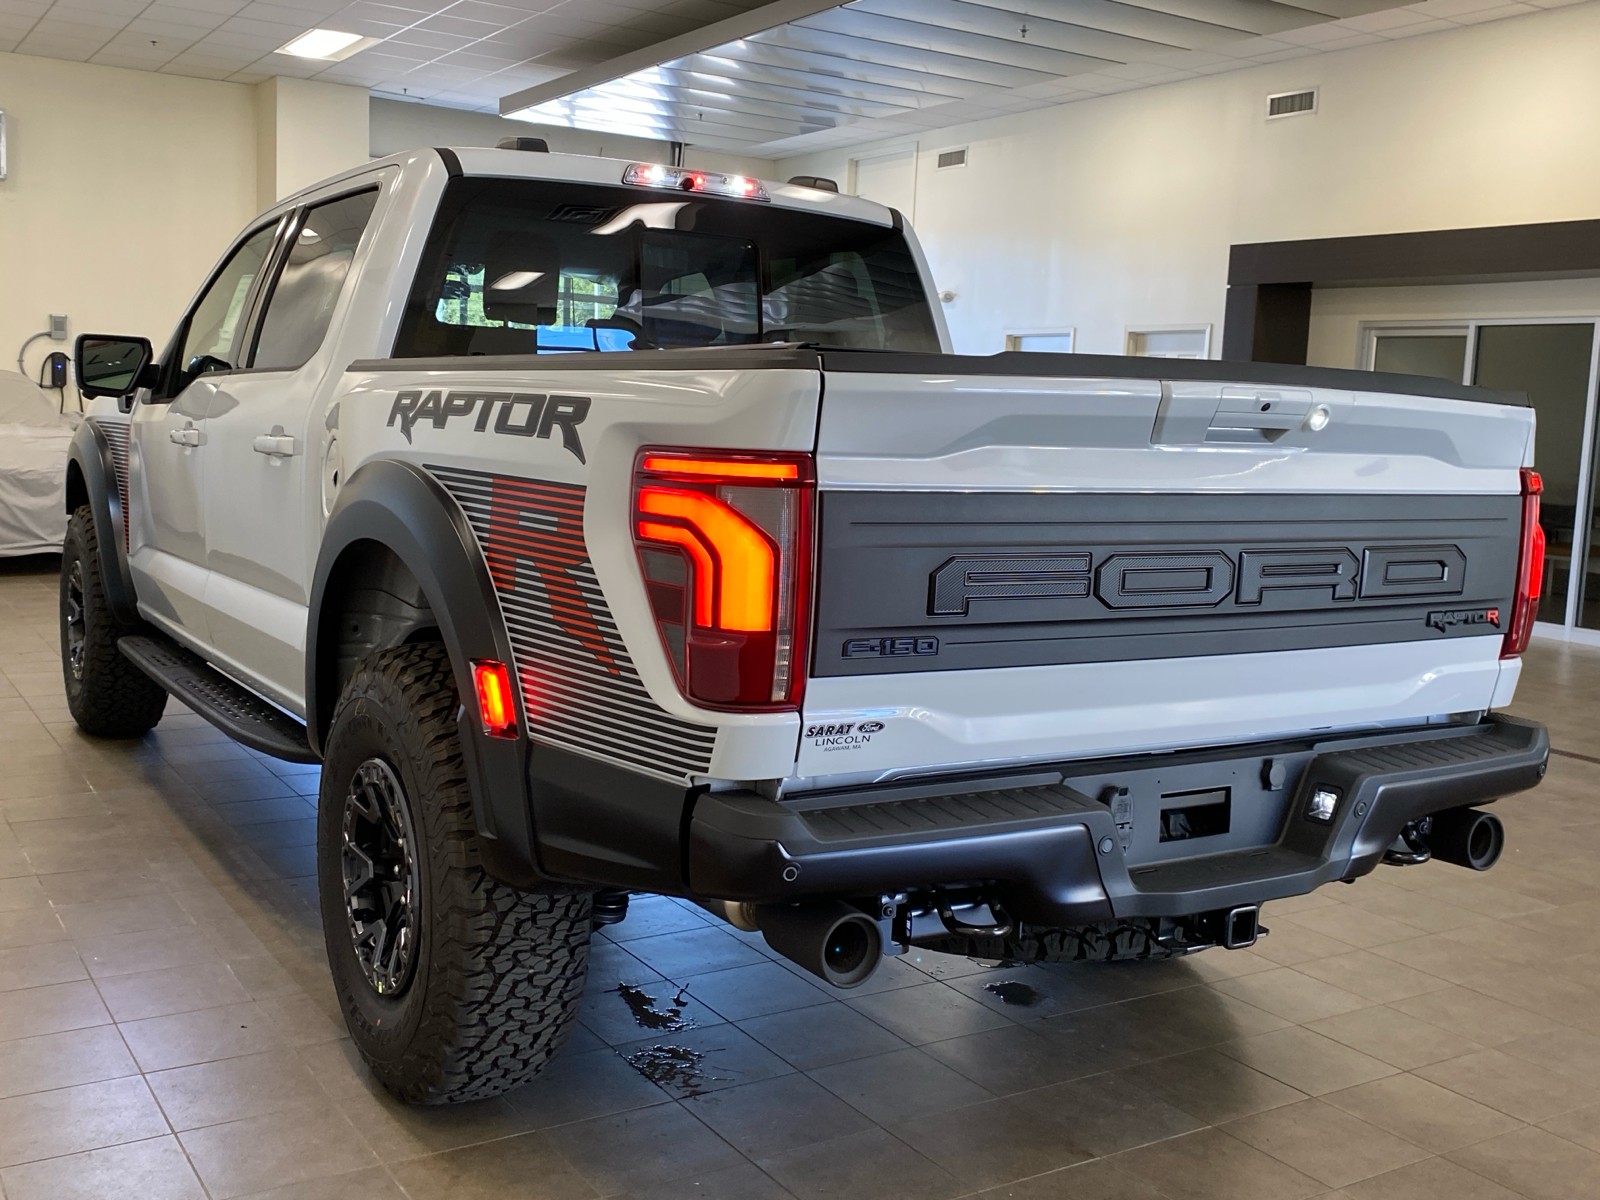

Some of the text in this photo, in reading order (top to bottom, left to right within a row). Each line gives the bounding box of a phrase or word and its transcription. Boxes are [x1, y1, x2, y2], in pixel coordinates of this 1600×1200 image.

[386, 390, 591, 465] RAPTOR
[927, 544, 1467, 617] FORD
[1425, 607, 1500, 633] RAPTOR
[841, 635, 939, 660] F-150
[805, 722, 882, 738] SARAT Ford
[815, 735, 871, 746] LINCOLN
